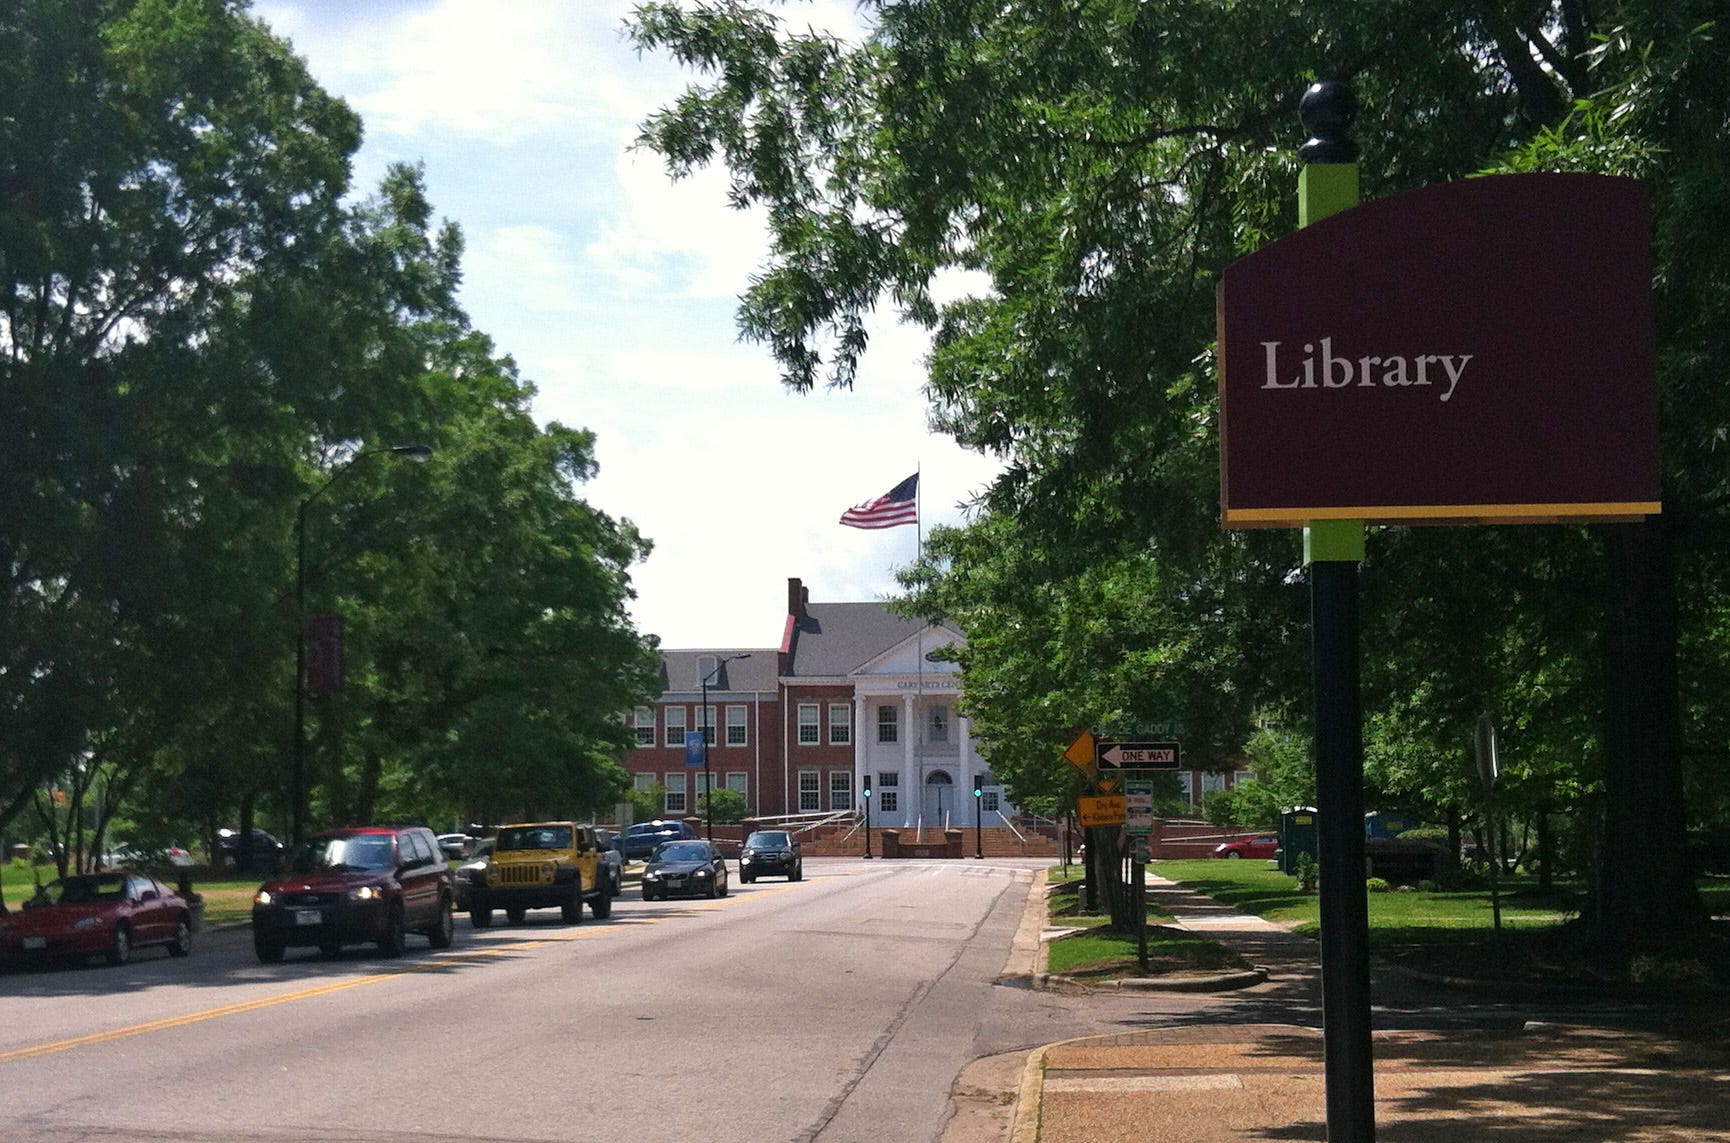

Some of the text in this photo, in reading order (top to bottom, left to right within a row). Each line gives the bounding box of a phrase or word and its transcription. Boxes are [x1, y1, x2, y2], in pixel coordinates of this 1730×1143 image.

[1259, 336, 1474, 402] Library
[1136, 723, 1170, 735] GADDY
[1122, 751, 1171, 761] ONE WAY
